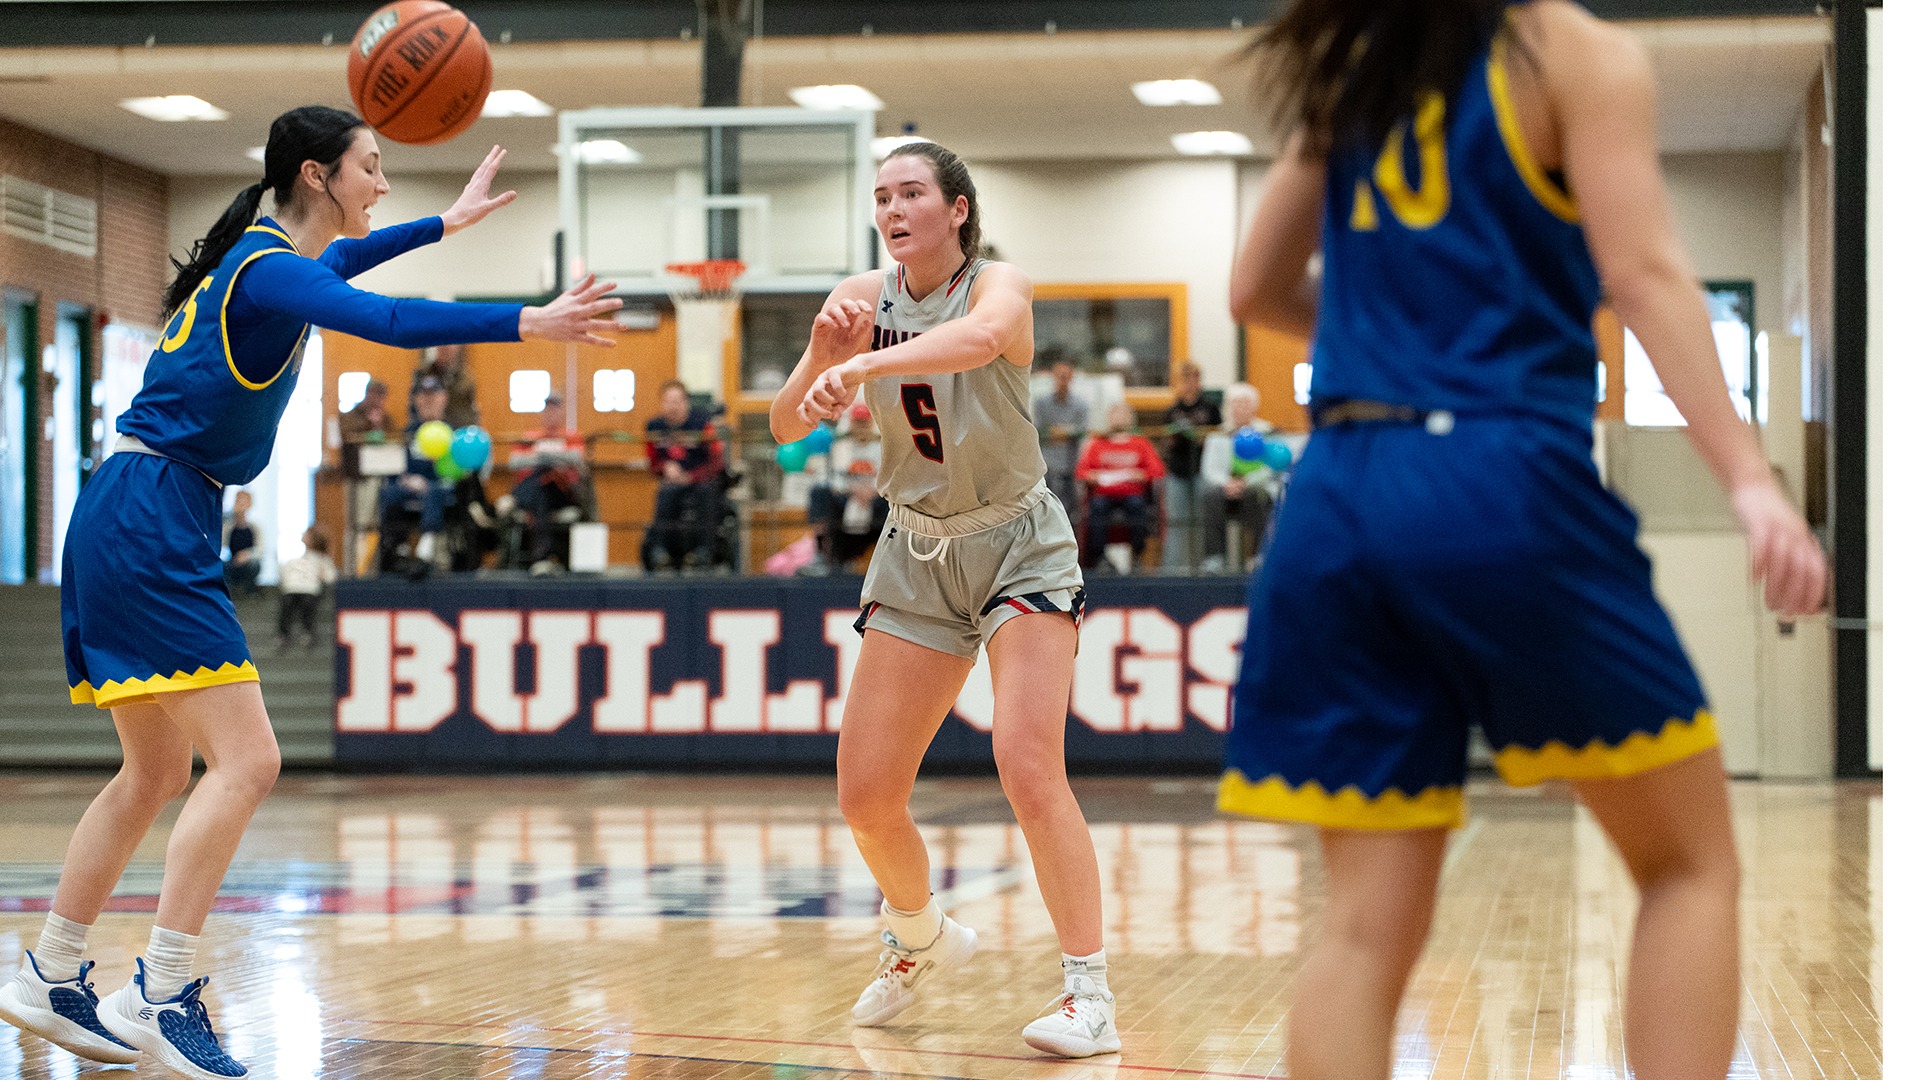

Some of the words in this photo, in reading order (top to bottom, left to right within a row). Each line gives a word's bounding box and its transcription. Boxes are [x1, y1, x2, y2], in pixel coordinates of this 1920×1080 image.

[372, 62, 410, 108] THE
[397, 25, 449, 72] ROCK
[1350, 88, 1451, 232] 0
[154, 275, 214, 353] 5
[900, 383, 944, 464] 5
[337, 608, 1249, 733] BULLG
